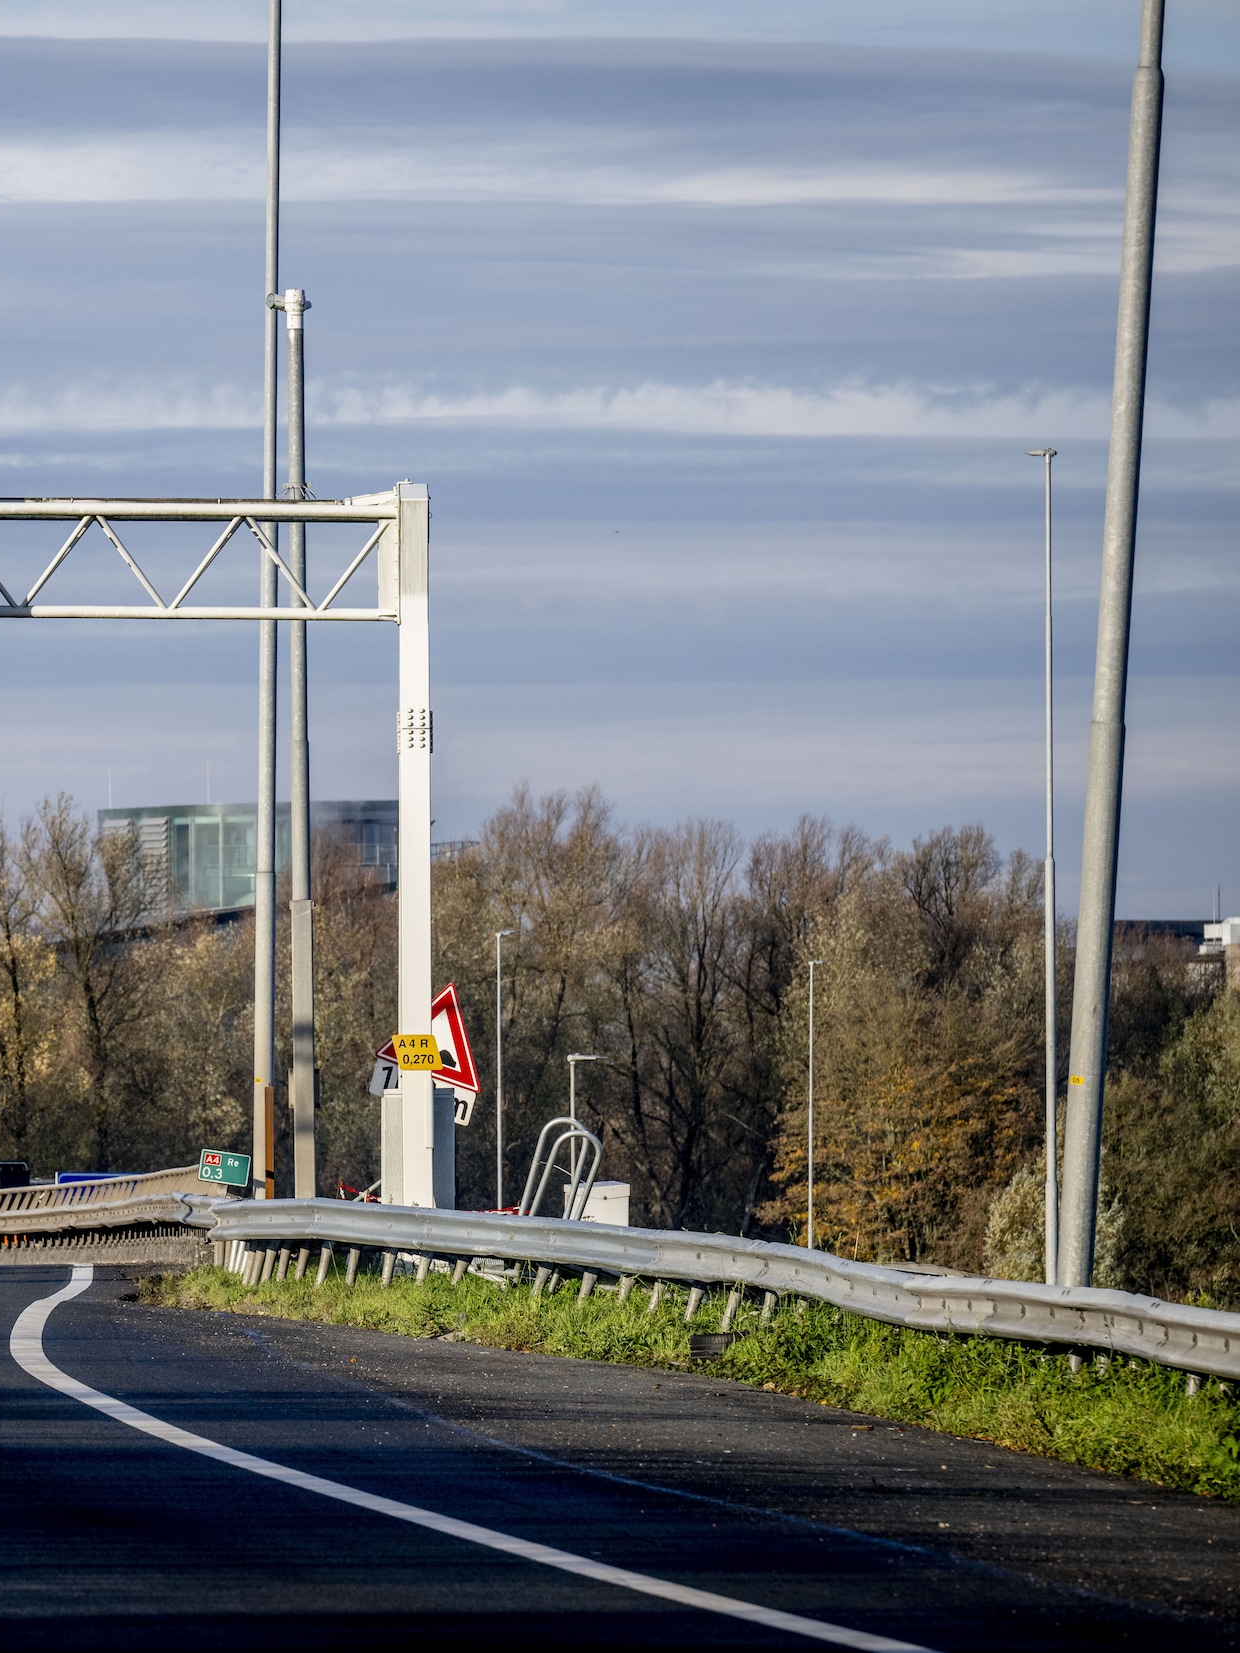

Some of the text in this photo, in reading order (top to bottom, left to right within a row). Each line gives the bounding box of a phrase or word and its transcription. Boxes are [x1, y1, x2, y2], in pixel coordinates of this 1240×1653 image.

[420, 1039, 428, 1048] R
[402, 1054, 435, 1066] 0,270
[206, 1155, 240, 1167] A4 Re
[202, 1166, 223, 1179] 0.3
